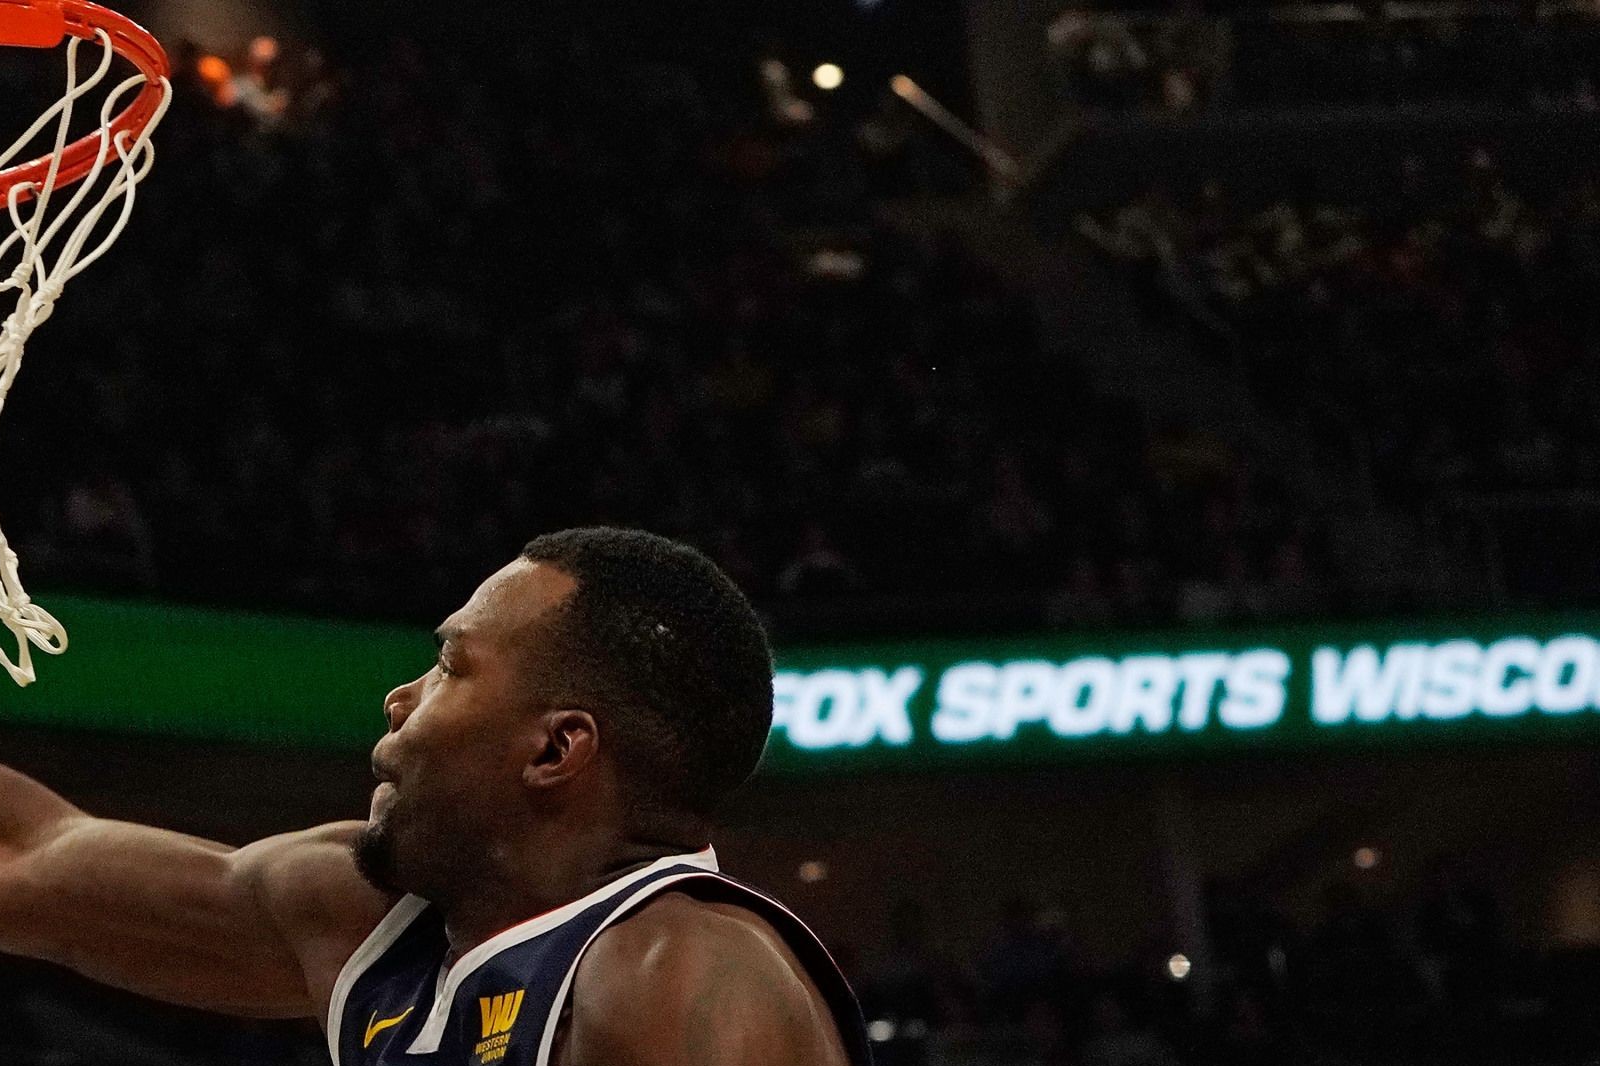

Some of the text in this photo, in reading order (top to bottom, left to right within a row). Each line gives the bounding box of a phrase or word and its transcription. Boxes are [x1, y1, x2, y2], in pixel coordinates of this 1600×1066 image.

[772, 634, 1600, 749] FOX SPORTS WISCO
